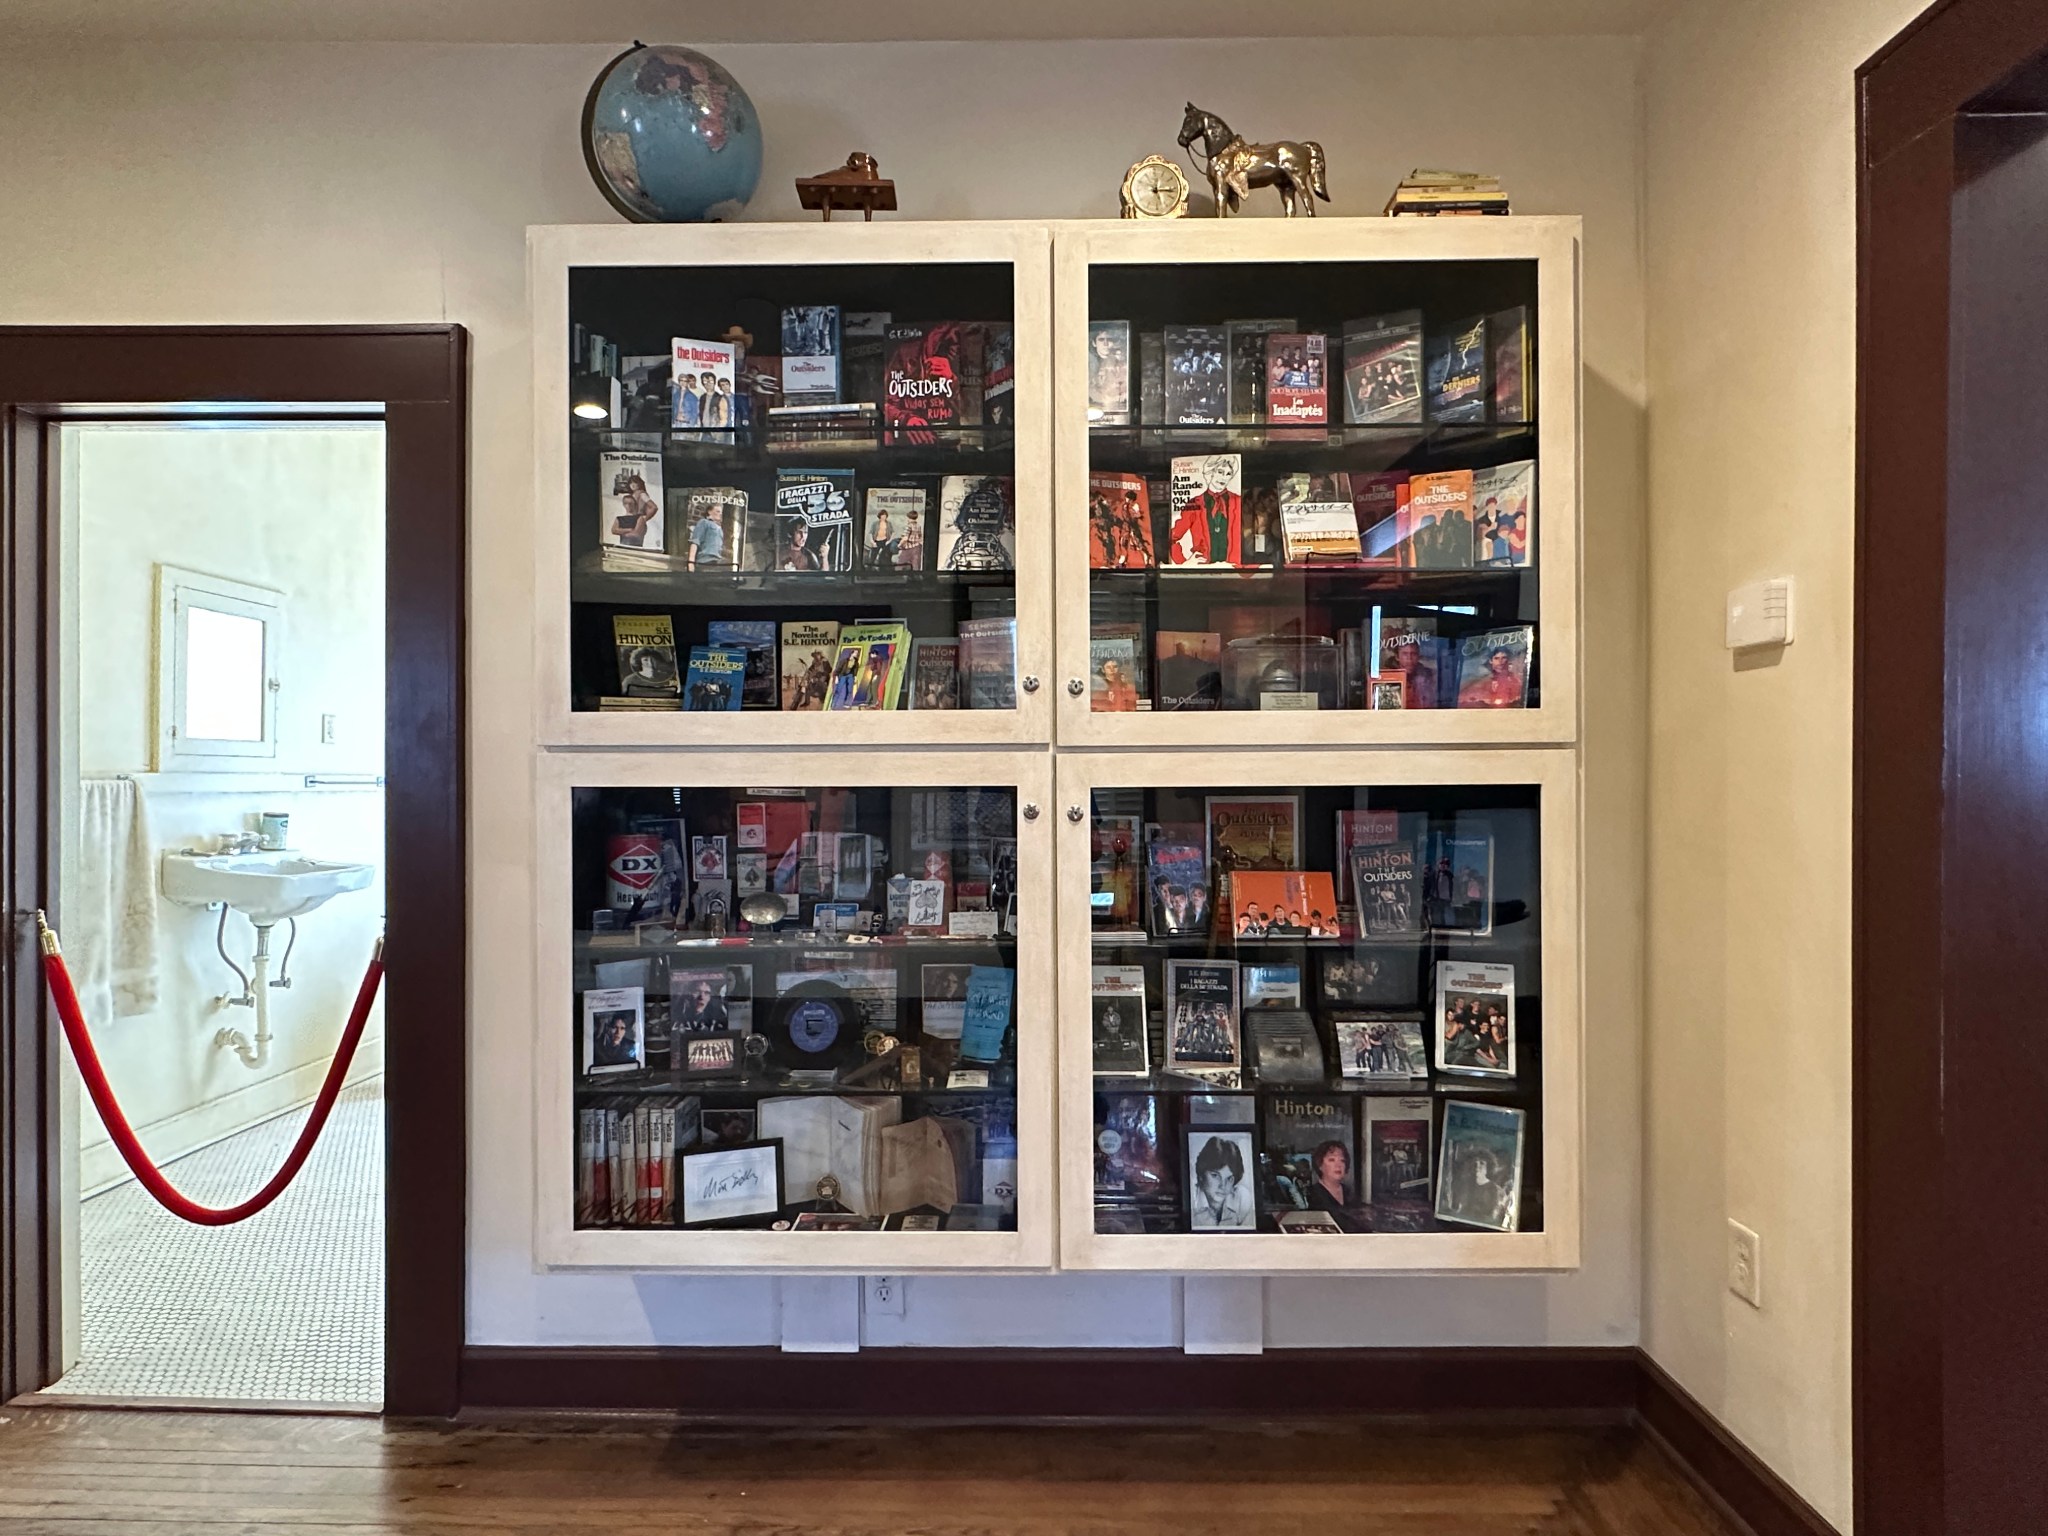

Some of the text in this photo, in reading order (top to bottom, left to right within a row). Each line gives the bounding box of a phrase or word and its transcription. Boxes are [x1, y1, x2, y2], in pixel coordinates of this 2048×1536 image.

[677, 346, 730, 364] the Outsiders
[889, 377, 953, 398] OUTSIDERS
[1292, 397, 1304, 405] Les
[927, 408, 953, 419] RUMO
[1273, 404, 1323, 418] Inadaptés
[1179, 415, 1214, 424] Outsiders
[621, 454, 659, 463] Outsiders
[1101, 479, 1142, 490] OUTSIDERS
[1173, 481, 1203, 490] Rande
[1430, 485, 1450, 494] THE
[781, 485, 827, 499] I RAGAZZI
[691, 495, 745, 507] OUTSIDERS
[787, 495, 807, 504] DELLA
[1414, 492, 1467, 505] OUTSIDERS
[811, 510, 849, 522] STRADA
[618, 634, 672, 645] HINTON
[708, 653, 728, 661] THE
[919, 648, 956, 657] HINTON
[689, 660, 743, 671] OUTSIDERS
[1161, 696, 1177, 704] The
[1216, 811, 1289, 828] Outsiders
[1351, 824, 1393, 833] HINTON
[622, 858, 658, 871] DX
[1358, 852, 1413, 868] HINTON
[1363, 870, 1413, 882] OUTSIDERS
[1467, 973, 1486, 981] THE
[1451, 980, 1503, 989] OUTSIDERS
[1275, 1099, 1335, 1115] Hinton
[995, 1187, 1013, 1195] DX
